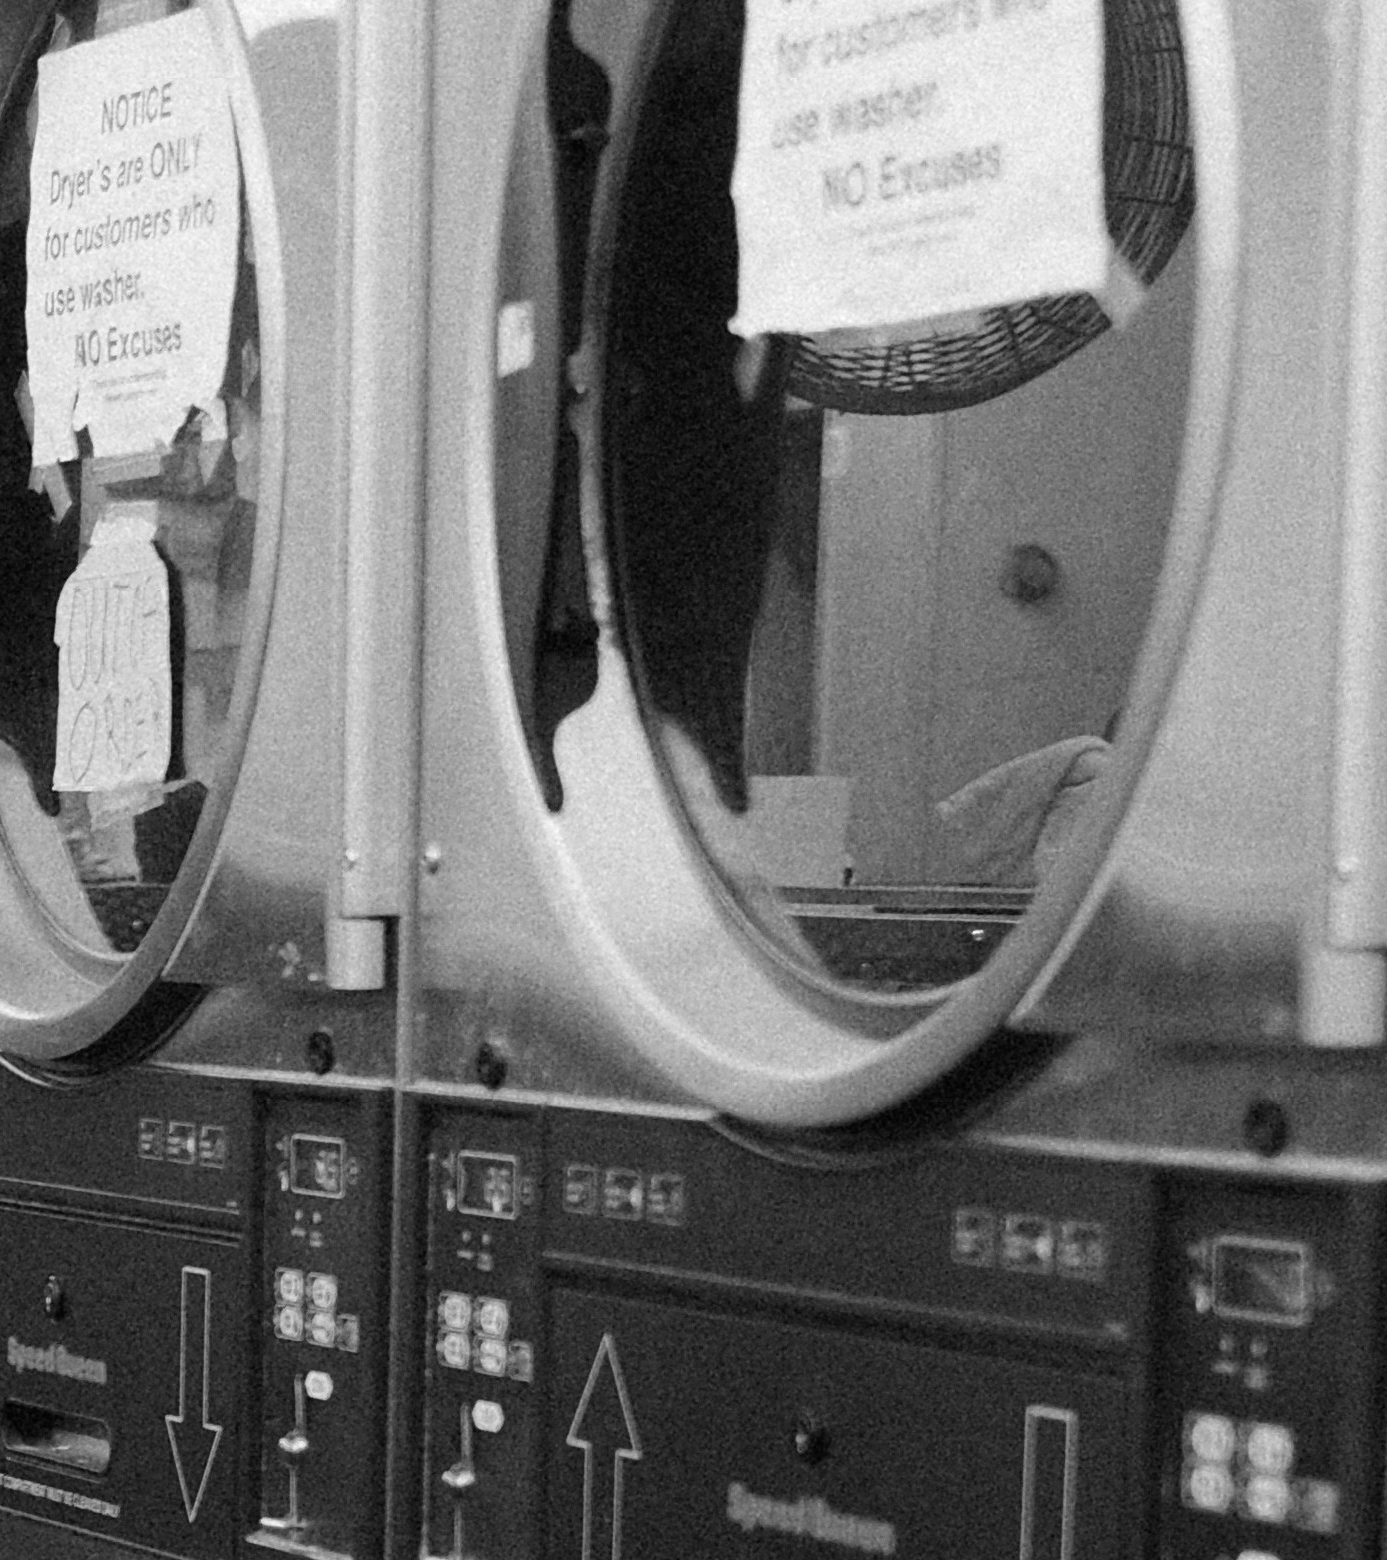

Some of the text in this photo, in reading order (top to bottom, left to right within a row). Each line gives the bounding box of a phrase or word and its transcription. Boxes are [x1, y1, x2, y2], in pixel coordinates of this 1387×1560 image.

[100, 81, 173, 135] NOTICE
[771, 108, 820, 150] use
[49, 134, 203, 211] Dryer's are ONLY
[822, 142, 1004, 216] NO Excuses
[44, 193, 217, 261] for customers who
[44, 268, 146, 318] use washer.
[74, 321, 184, 367] NO Excuses
